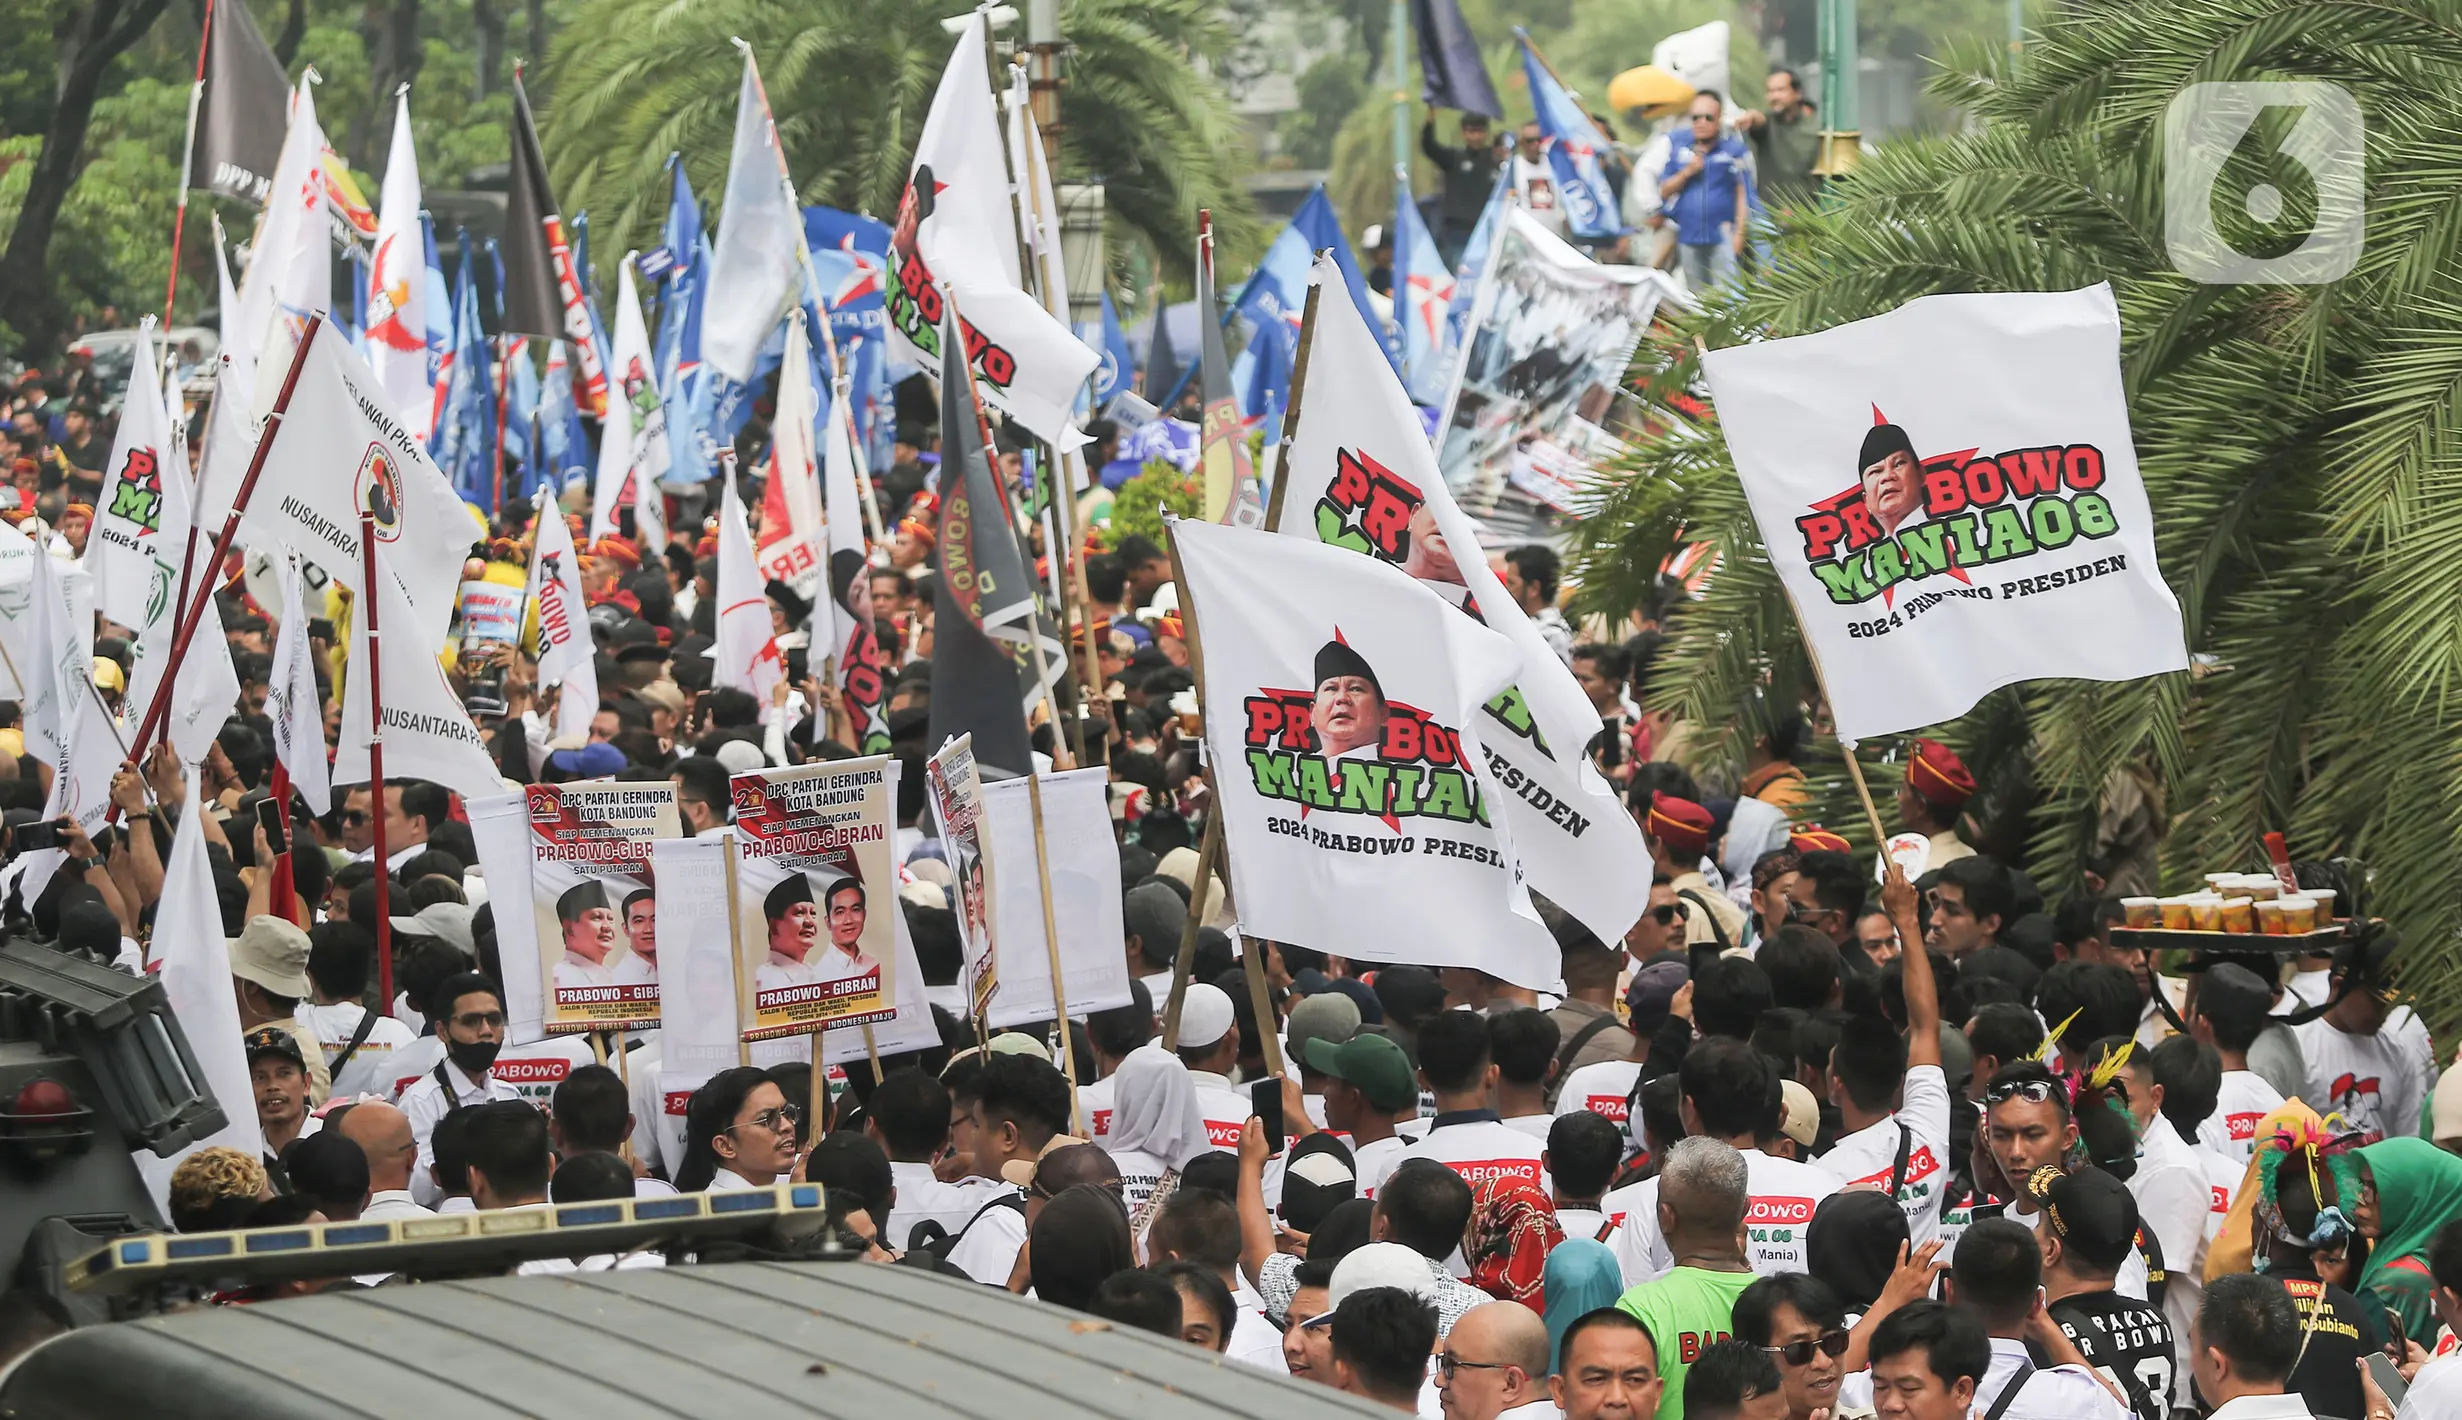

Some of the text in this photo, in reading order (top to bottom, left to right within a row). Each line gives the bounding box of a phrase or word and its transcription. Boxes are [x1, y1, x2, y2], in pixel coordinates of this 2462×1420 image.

[1796, 444, 2106, 561] PRBOWO
[102, 528, 140, 551] 2024
[280, 495, 360, 559] NUSANTARA
[1810, 491, 2120, 605] MANIA08
[1848, 554, 2127, 638] 2024 PRABOWO PRESIDEN
[380, 705, 469, 742] NUSANTARA
[767, 770, 883, 799] DPC PARTAI GERINDRA
[562, 790, 673, 807] DPC PARTAI GERINDRA
[787, 787, 865, 813] KOTA BANDUNG
[580, 806, 657, 821] KOTA BANDUNG
[762, 811, 861, 834] SIAP MEMENANGKAN
[556, 827, 655, 839] SIAP MEMENANGKAN
[742, 823, 884, 860] PRABOWO-GIBRAN
[1268, 816, 1308, 841] 2024
[1312, 827, 1415, 856] PRABOWO
[574, 862, 643, 875] SATU PUTARAN
[780, 851, 847, 870] SATU PUTARAN
[559, 988, 621, 1002] PRABOWO
[760, 986, 820, 1006] PRABOWO
[833, 976, 877, 995] GIBRAN
[550, 1024, 588, 1032] PRABOWO
[595, 1022, 624, 1031] GIBRAN
[750, 1029, 787, 1040] PRABOWO
[794, 1023, 822, 1034] GIBRAN
[828, 1016, 870, 1029] INDONESIA
[872, 1011, 894, 1021] MAJU
